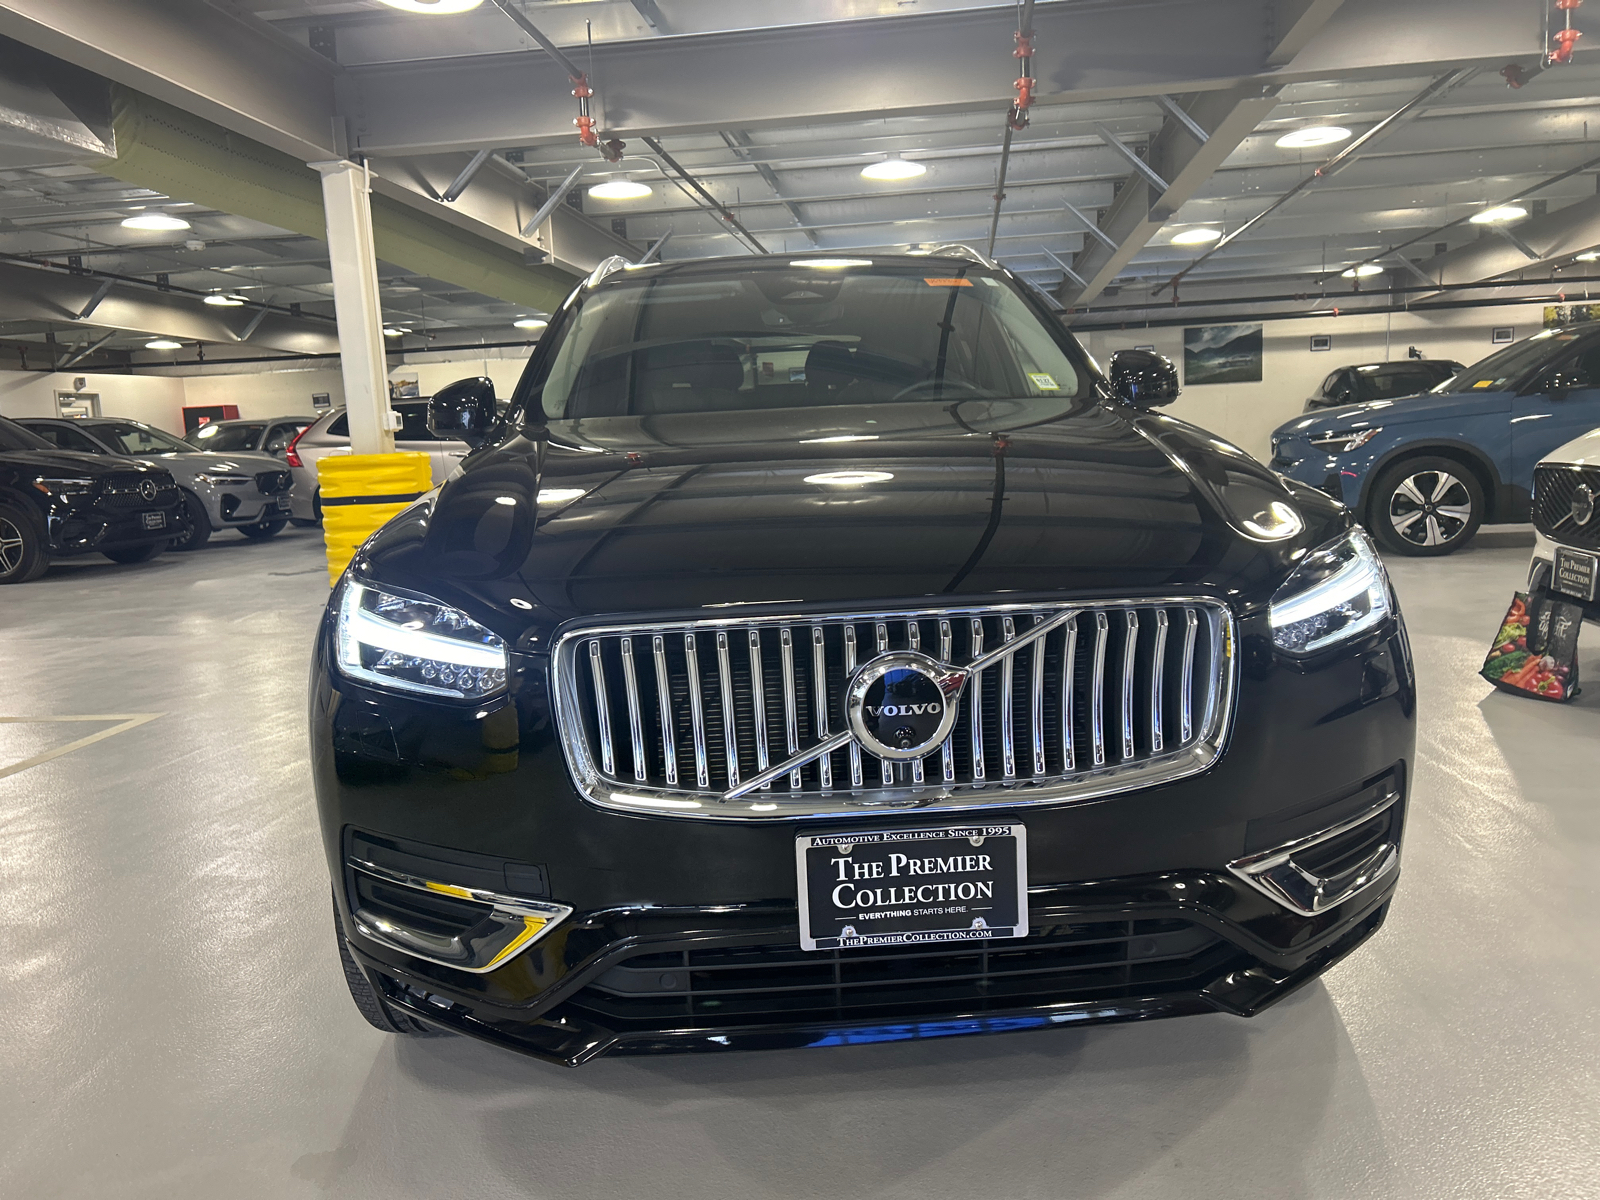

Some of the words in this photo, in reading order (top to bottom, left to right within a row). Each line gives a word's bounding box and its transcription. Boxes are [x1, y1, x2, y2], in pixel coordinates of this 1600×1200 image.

[865, 702, 941, 717] VOLVO
[813, 833, 880, 846] AUTOMOTIVE
[883, 830, 946, 841] EXCELLENCE
[948, 828, 978, 838] SINCE
[981, 826, 1010, 836] 1995
[830, 856, 884, 881] THE
[888, 853, 993, 877] PREMIER
[831, 880, 994, 909] COLLECTION
[858, 909, 912, 921] EVERYTHING
[913, 907, 944, 916] STARTS
[945, 905, 969, 914] HERE.
[836, 929, 993, 947] THEPREMIERCOLLECTION.COM
